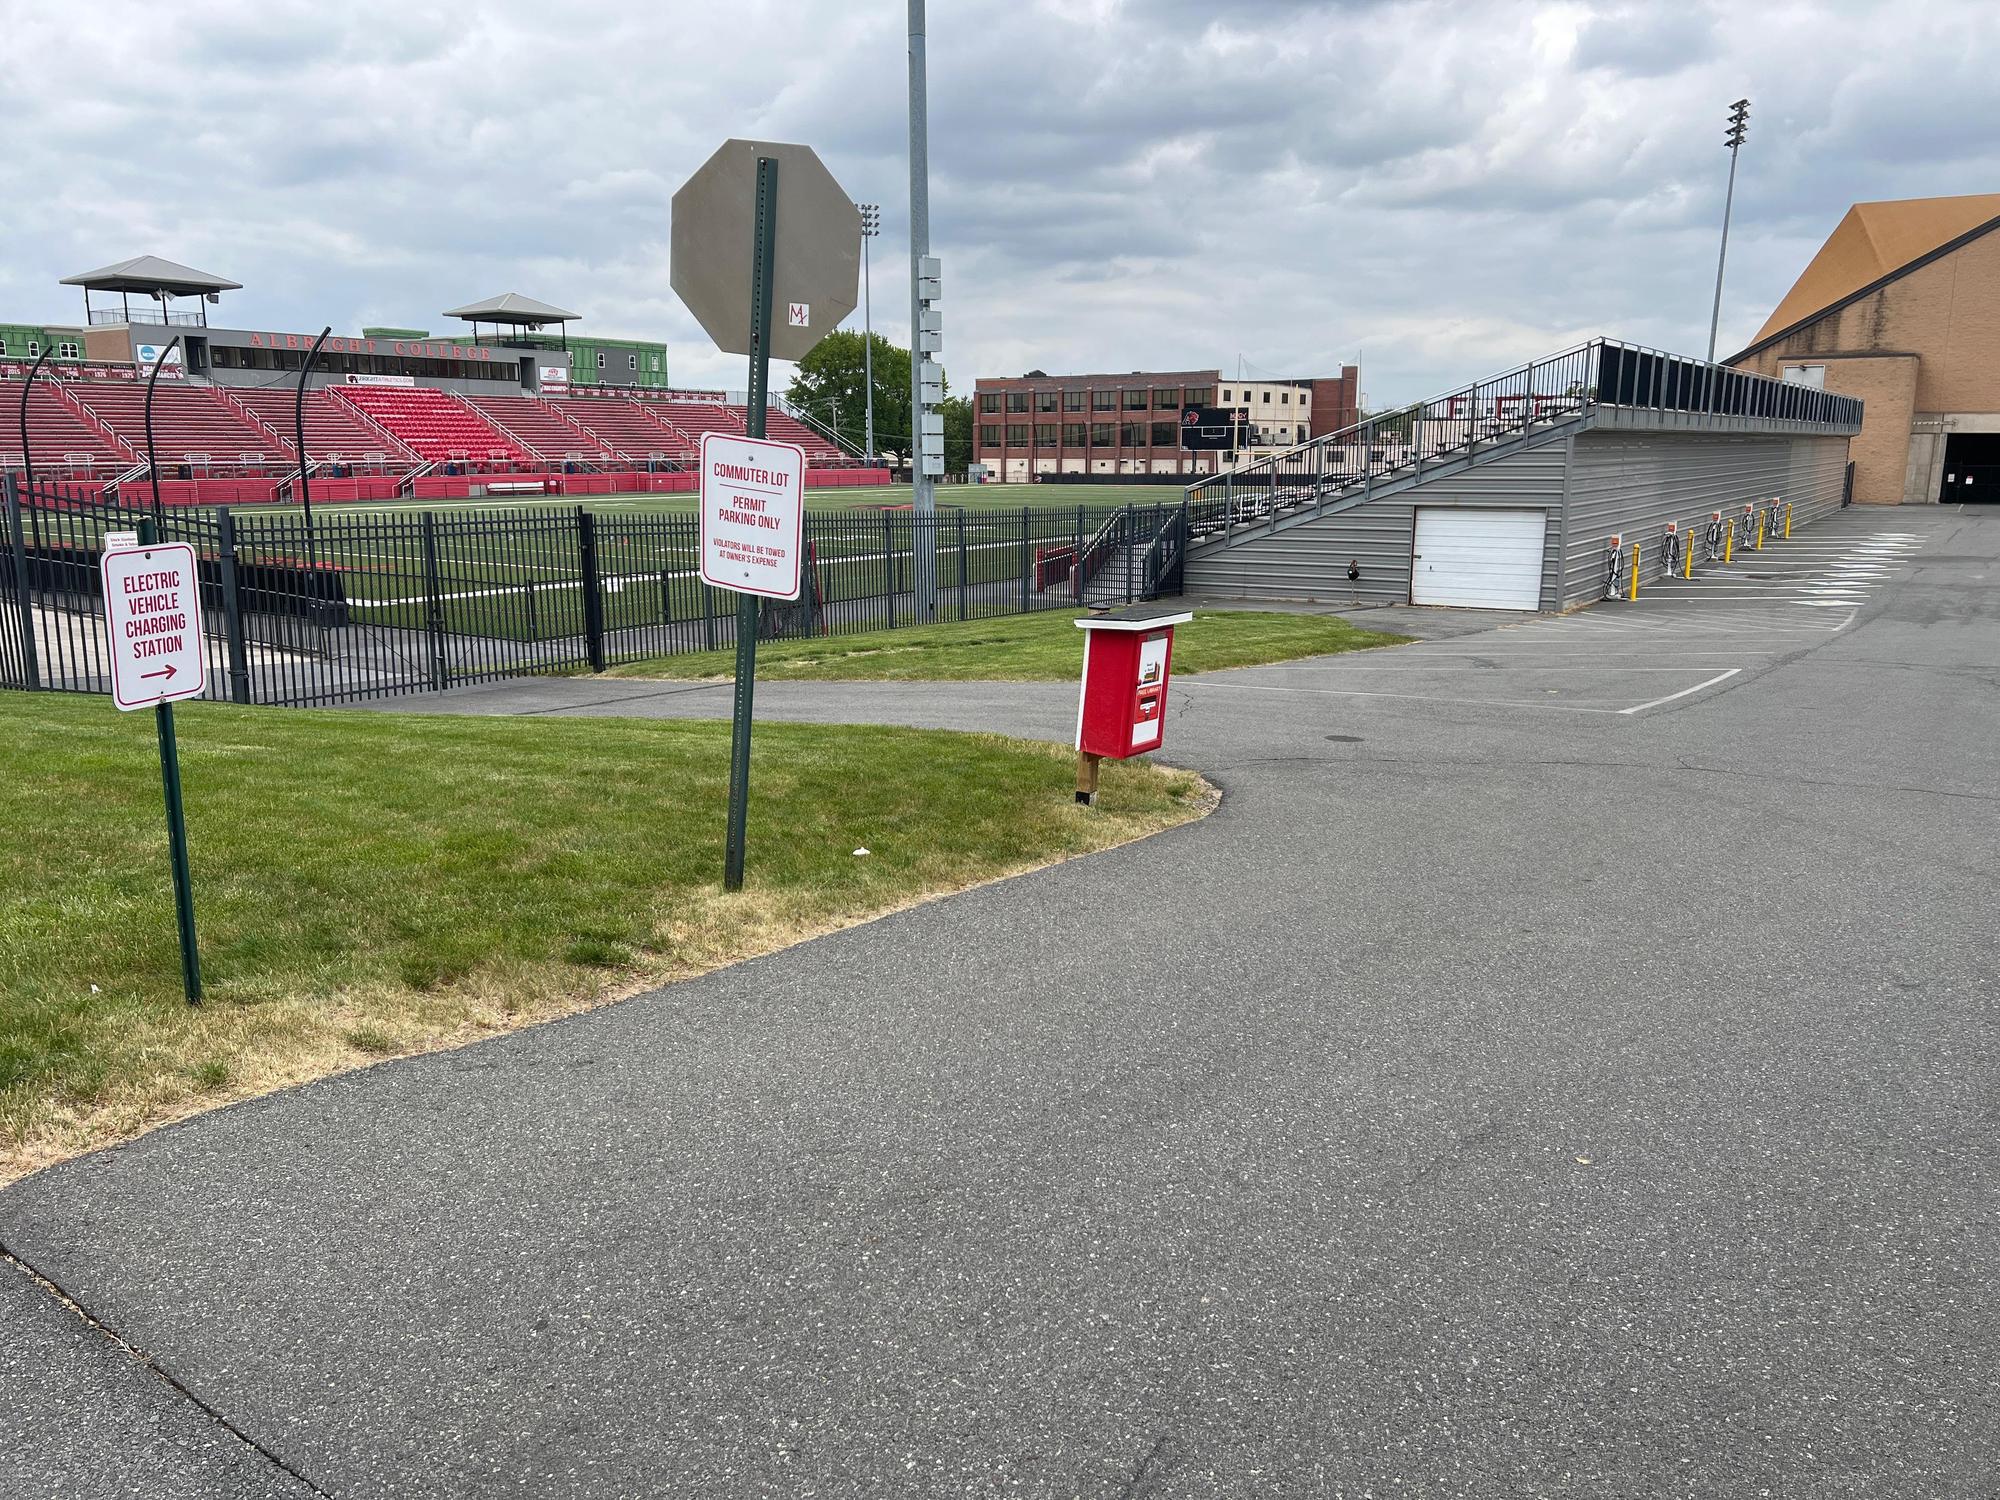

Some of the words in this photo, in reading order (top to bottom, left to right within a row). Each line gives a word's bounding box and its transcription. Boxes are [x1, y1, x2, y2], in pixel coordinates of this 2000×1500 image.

[395, 342, 490, 360] COLLEGE
[714, 462, 768, 484] COMMUTER
[770, 472, 789, 488] LOT
[733, 496, 766, 512] PERMIT
[719, 509, 756, 526] PARKING
[758, 515, 780, 530] ONLY
[713, 538, 740, 551] VIOLATORS
[742, 542, 755, 553] WILL
[756, 545, 764, 554] BE
[766, 547, 785, 558] TOWED
[720, 550, 726, 558] AT
[726, 551, 751, 563] OWNER'S
[752, 556, 778, 568] EXPENSE
[124, 571, 180, 594] ELECTRIC
[128, 592, 178, 615] VEHICLE
[126, 614, 186, 638] CHARGING
[134, 635, 182, 658] STATION
